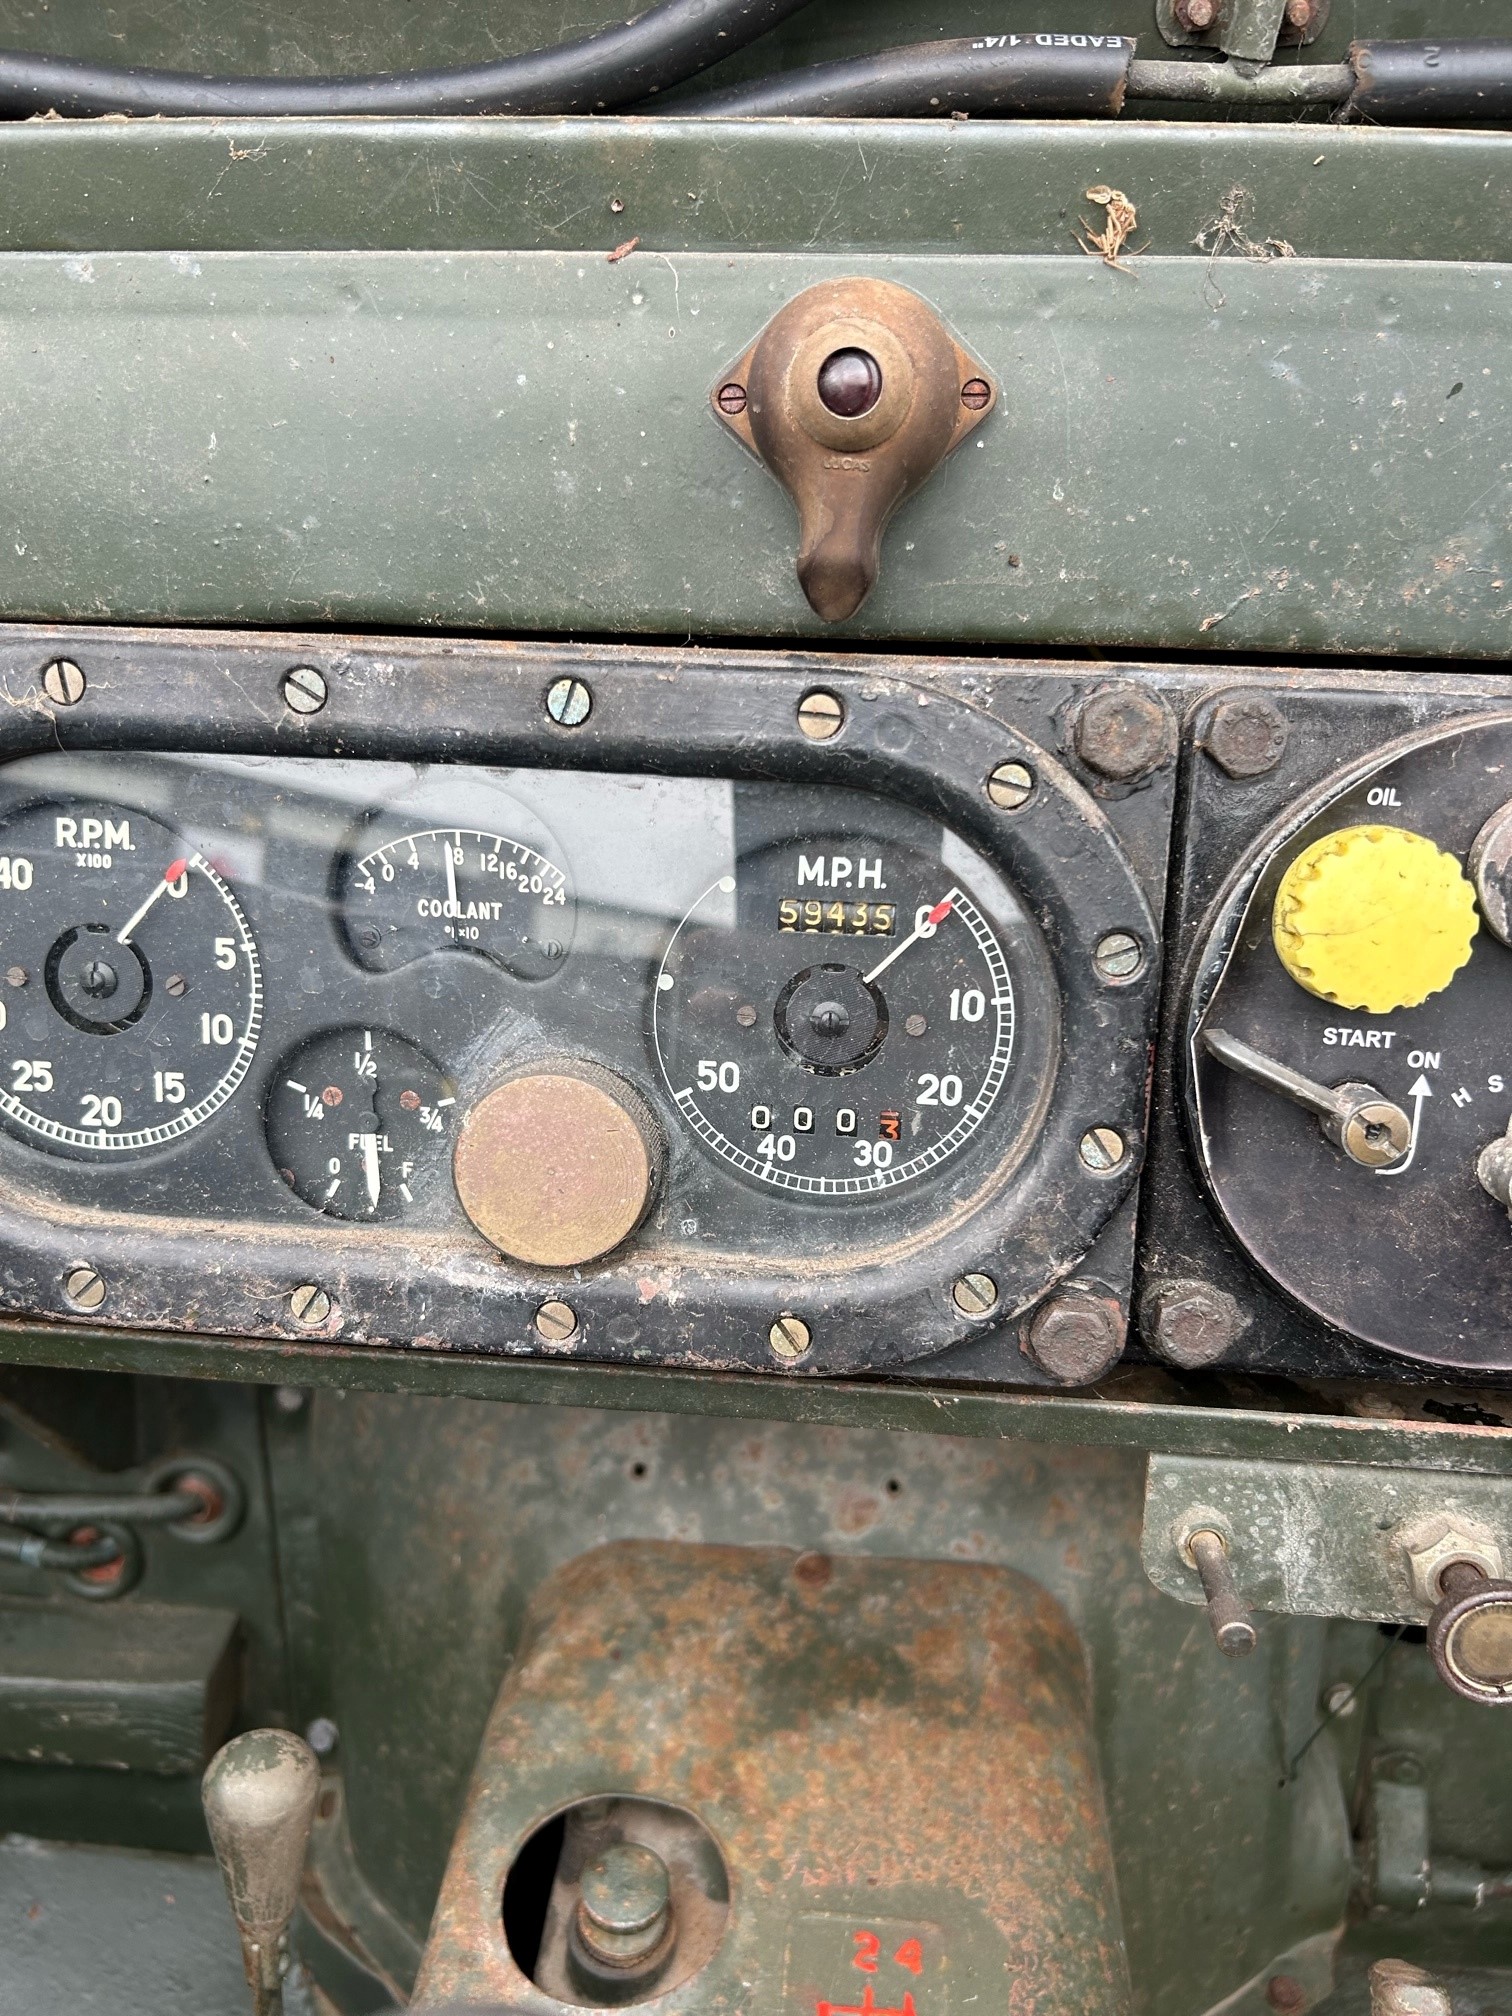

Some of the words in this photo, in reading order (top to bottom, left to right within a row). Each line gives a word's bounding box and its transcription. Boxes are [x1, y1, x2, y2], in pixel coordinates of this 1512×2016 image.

[823, 456, 872, 472] LUCAS
[1367, 787, 1402, 807] OIL
[56, 817, 136, 851] R.P.M.
[76, 853, 112, 869] X100
[354, 877, 375, 894] -4
[382, 864, 395, 882] 0
[407, 852, 420, 870] 4
[453, 847, 465, 865] 8
[480, 853, 499, 872] 12
[499, 861, 518, 880] 16
[518, 877, 543, 894] 20
[543, 887, 567, 906] 24
[797, 855, 888, 890] M.P.H.
[417, 899, 503, 920] COOLANT
[778, 900, 893, 931] 59435
[914, 904, 938, 939] 0
[214, 937, 237, 971] 5
[949, 988, 986, 1022] 10
[201, 1012, 234, 1045] 10
[1322, 1027, 1397, 1049] START
[354, 1051, 378, 1079] 1/2
[1407, 1050, 1441, 1069] ON
[12, 1060, 54, 1093] 25
[153, 1071, 187, 1103] 15
[697, 1060, 740, 1093] 50
[916, 1073, 963, 1106] 20
[1450, 1086, 1473, 1108] H
[1487, 1074, 1504, 1093] S
[80, 1094, 123, 1127] 20
[304, 1093, 325, 1120] 1/4
[419, 1106, 444, 1133] 3/4
[756, 1133, 796, 1162] 40
[853, 1139, 893, 1168] 30
[329, 1157, 341, 1175] 0
[402, 1161, 414, 1179] F
[852, 1929, 881, 1973] 2
[893, 1936, 923, 1976] 4
